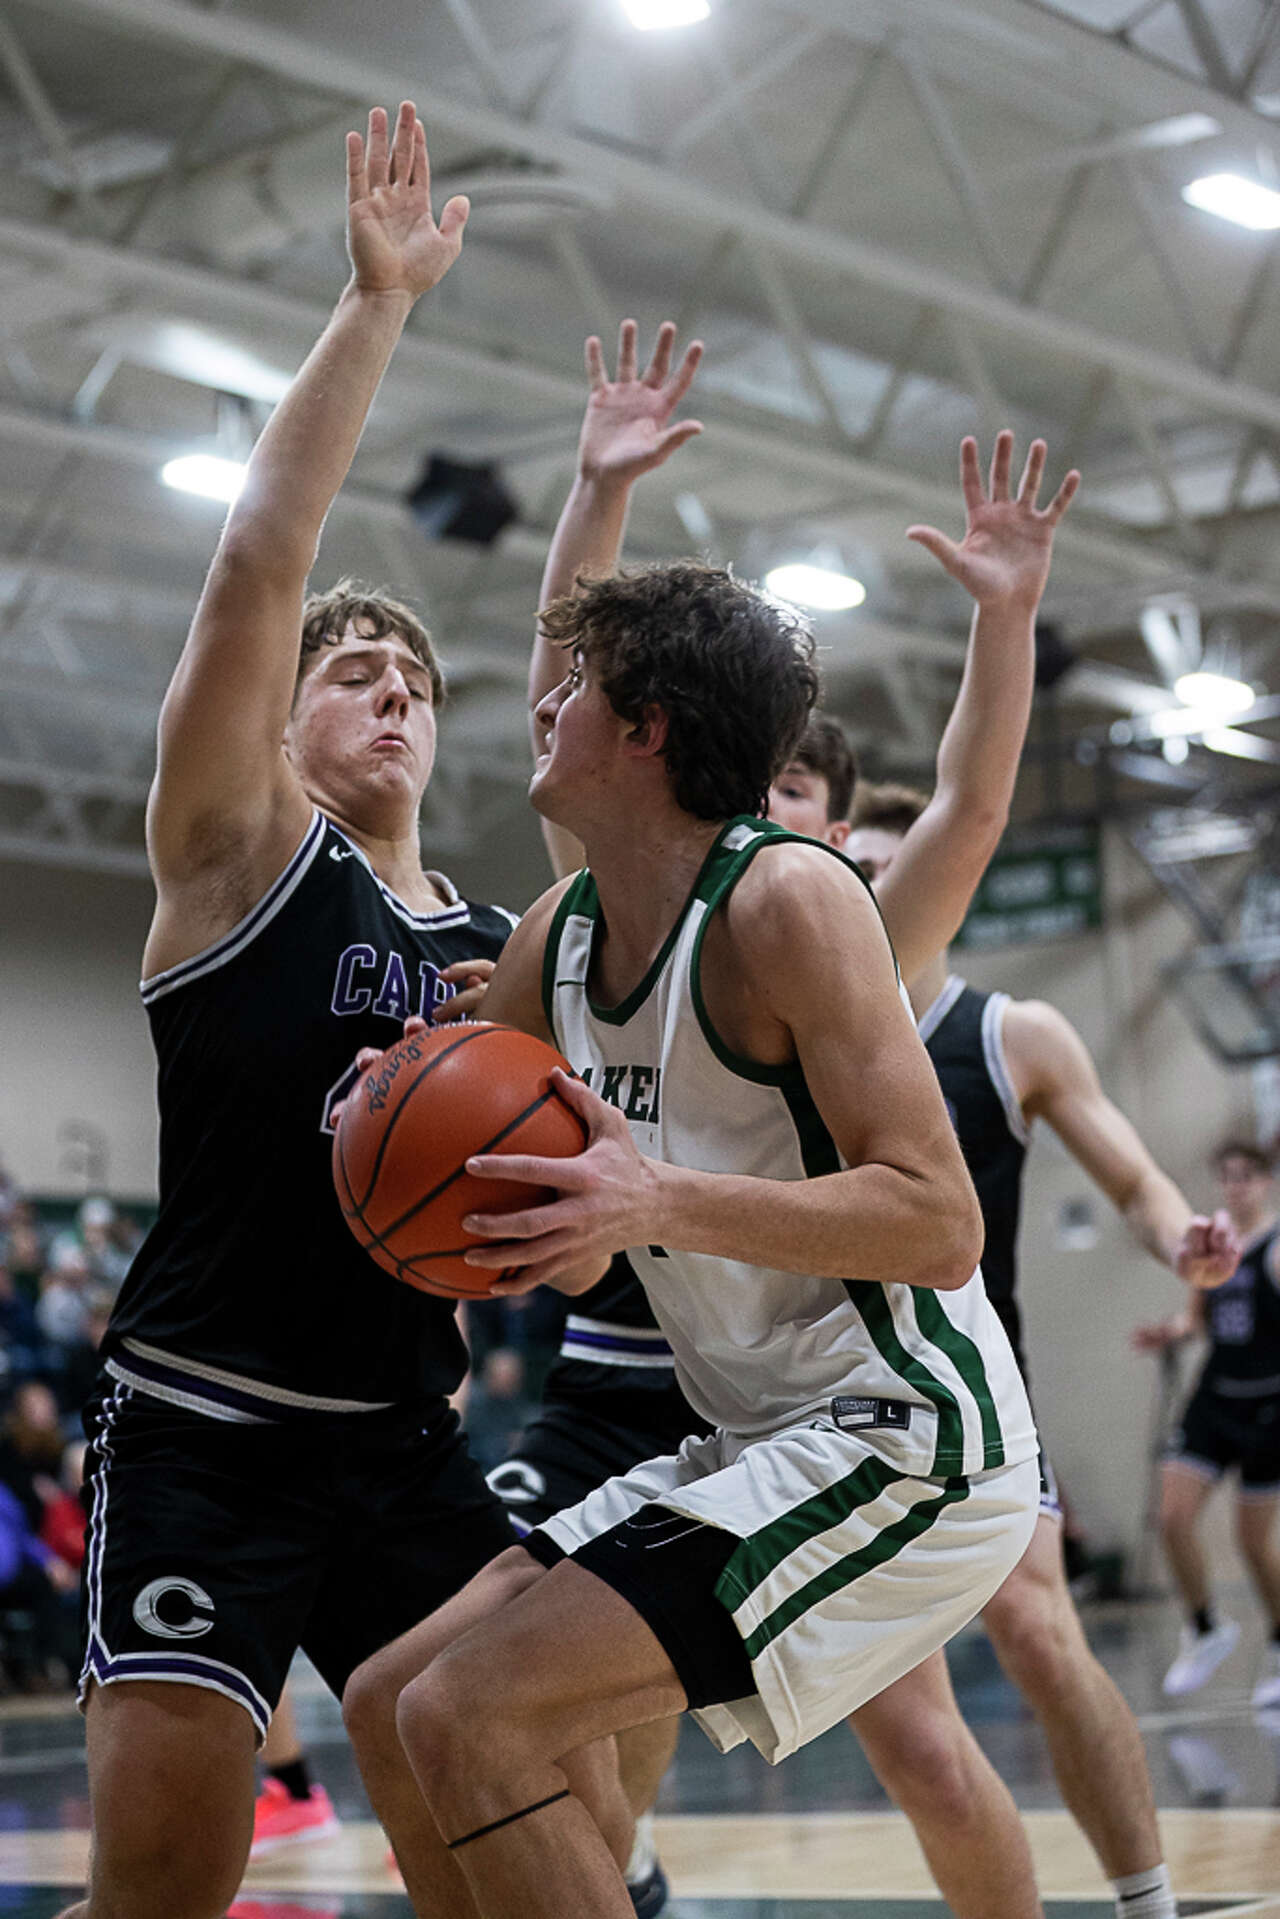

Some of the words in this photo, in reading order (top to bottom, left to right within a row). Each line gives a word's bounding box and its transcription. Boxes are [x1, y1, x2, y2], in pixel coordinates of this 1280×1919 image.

[366, 1030, 431, 1116] lings
[887, 1405, 897, 1419] L
[133, 1576, 216, 1639] C
